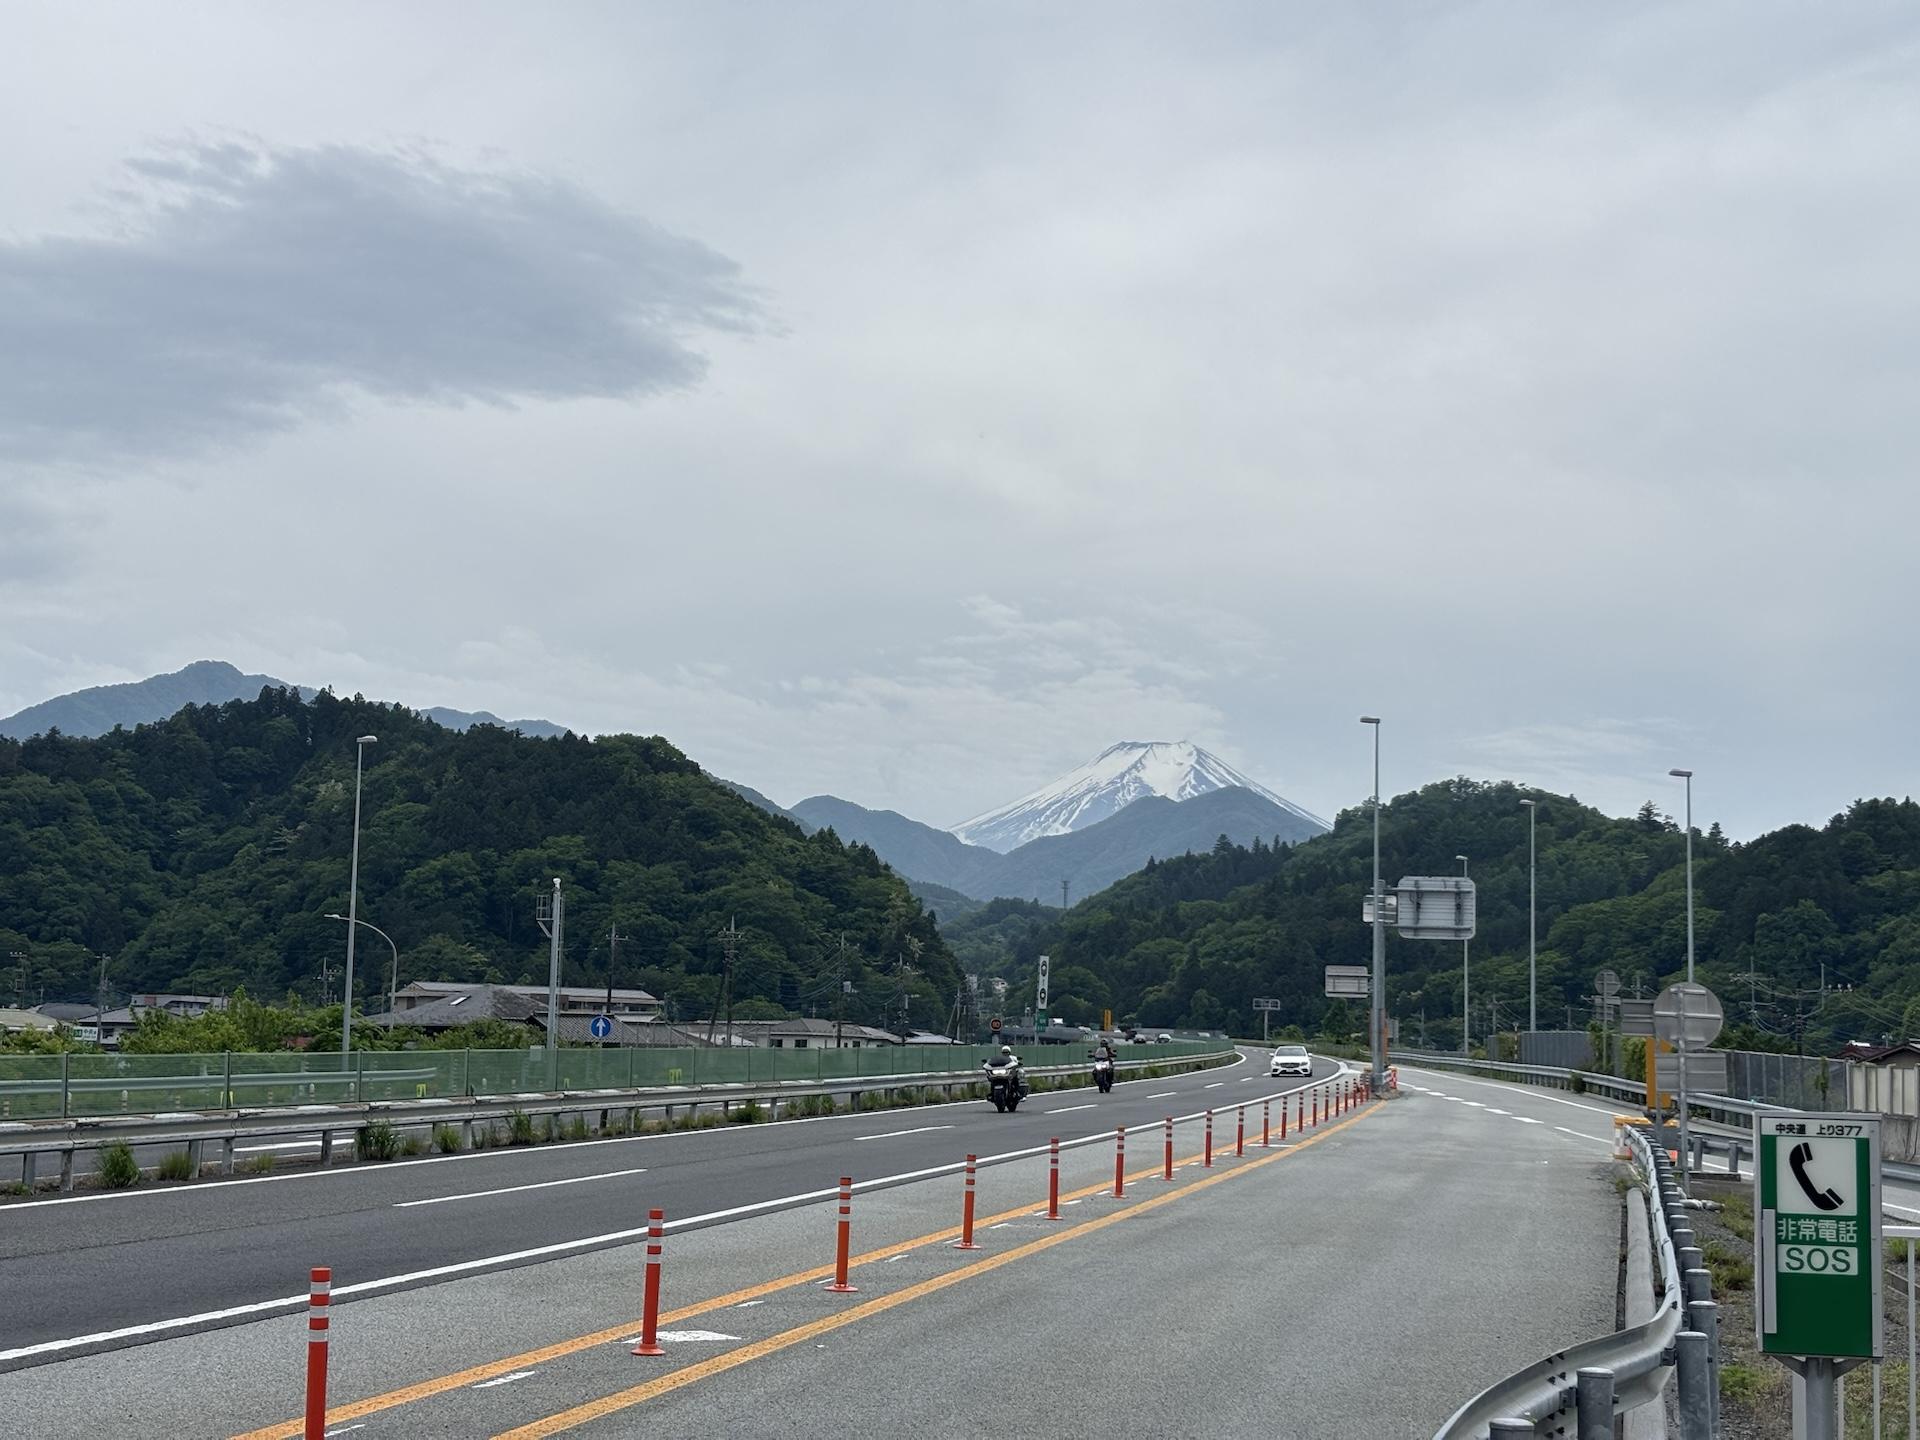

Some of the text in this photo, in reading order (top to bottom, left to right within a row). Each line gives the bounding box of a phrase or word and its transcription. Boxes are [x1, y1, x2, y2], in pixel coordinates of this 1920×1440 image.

[1775, 1122, 1863, 1137] 中央道 上り377
[1777, 1217, 1858, 1243] 非常電話
[1785, 1246, 1851, 1273] SOS
